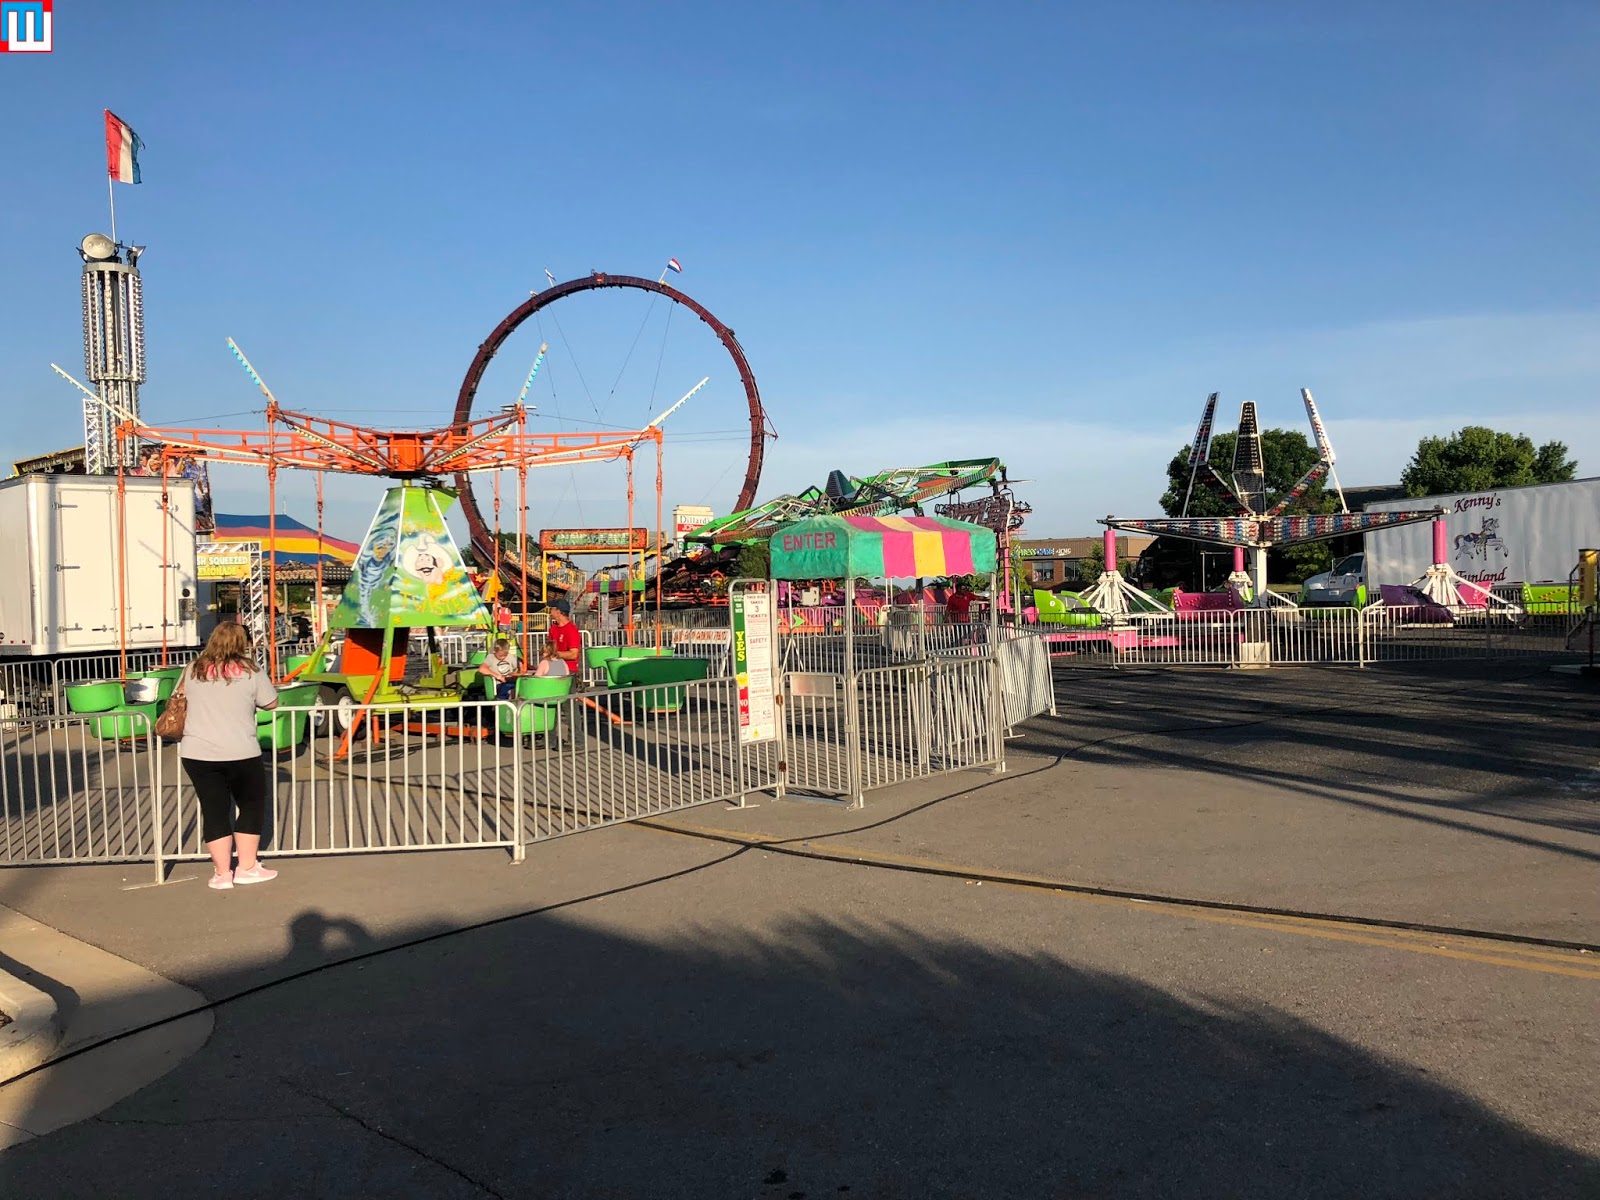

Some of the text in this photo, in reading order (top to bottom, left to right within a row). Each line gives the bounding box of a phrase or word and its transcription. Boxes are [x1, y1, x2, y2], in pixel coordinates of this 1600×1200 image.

[1454, 493, 1501, 514] Kenny's
[783, 531, 837, 551] ENTER
[197, 556, 248, 566] SH SQUEEZED
[197, 566, 237, 576] EMONADE
[1455, 566, 1508, 584] Funland
[754, 605, 760, 613] 3
[735, 630, 746, 662] YES
[749, 637, 768, 645] SAFETY
[739, 698, 748, 707] NO
